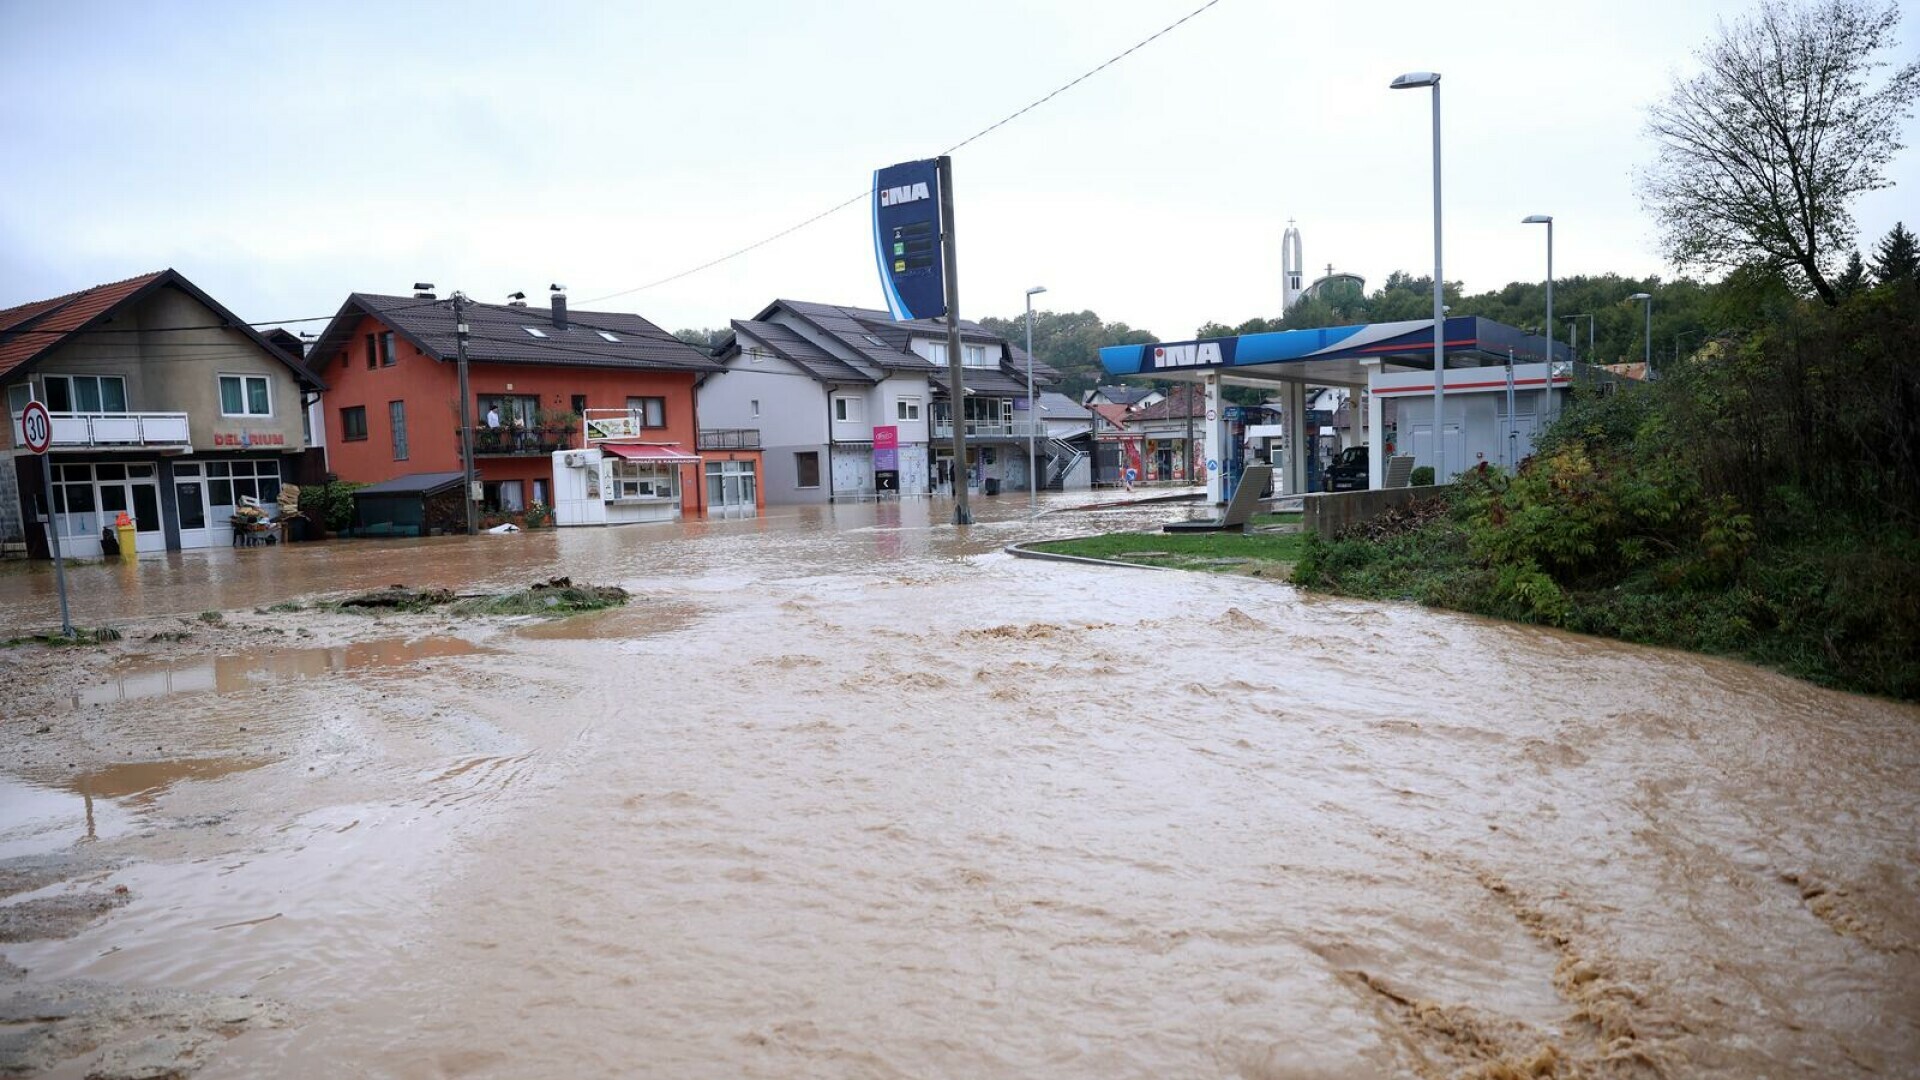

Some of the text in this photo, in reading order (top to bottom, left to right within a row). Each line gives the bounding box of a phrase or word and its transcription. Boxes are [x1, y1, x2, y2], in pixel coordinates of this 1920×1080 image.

[881, 182, 929, 207] INA
[1154, 342, 1223, 367] INA
[28, 415, 45, 441] 30
